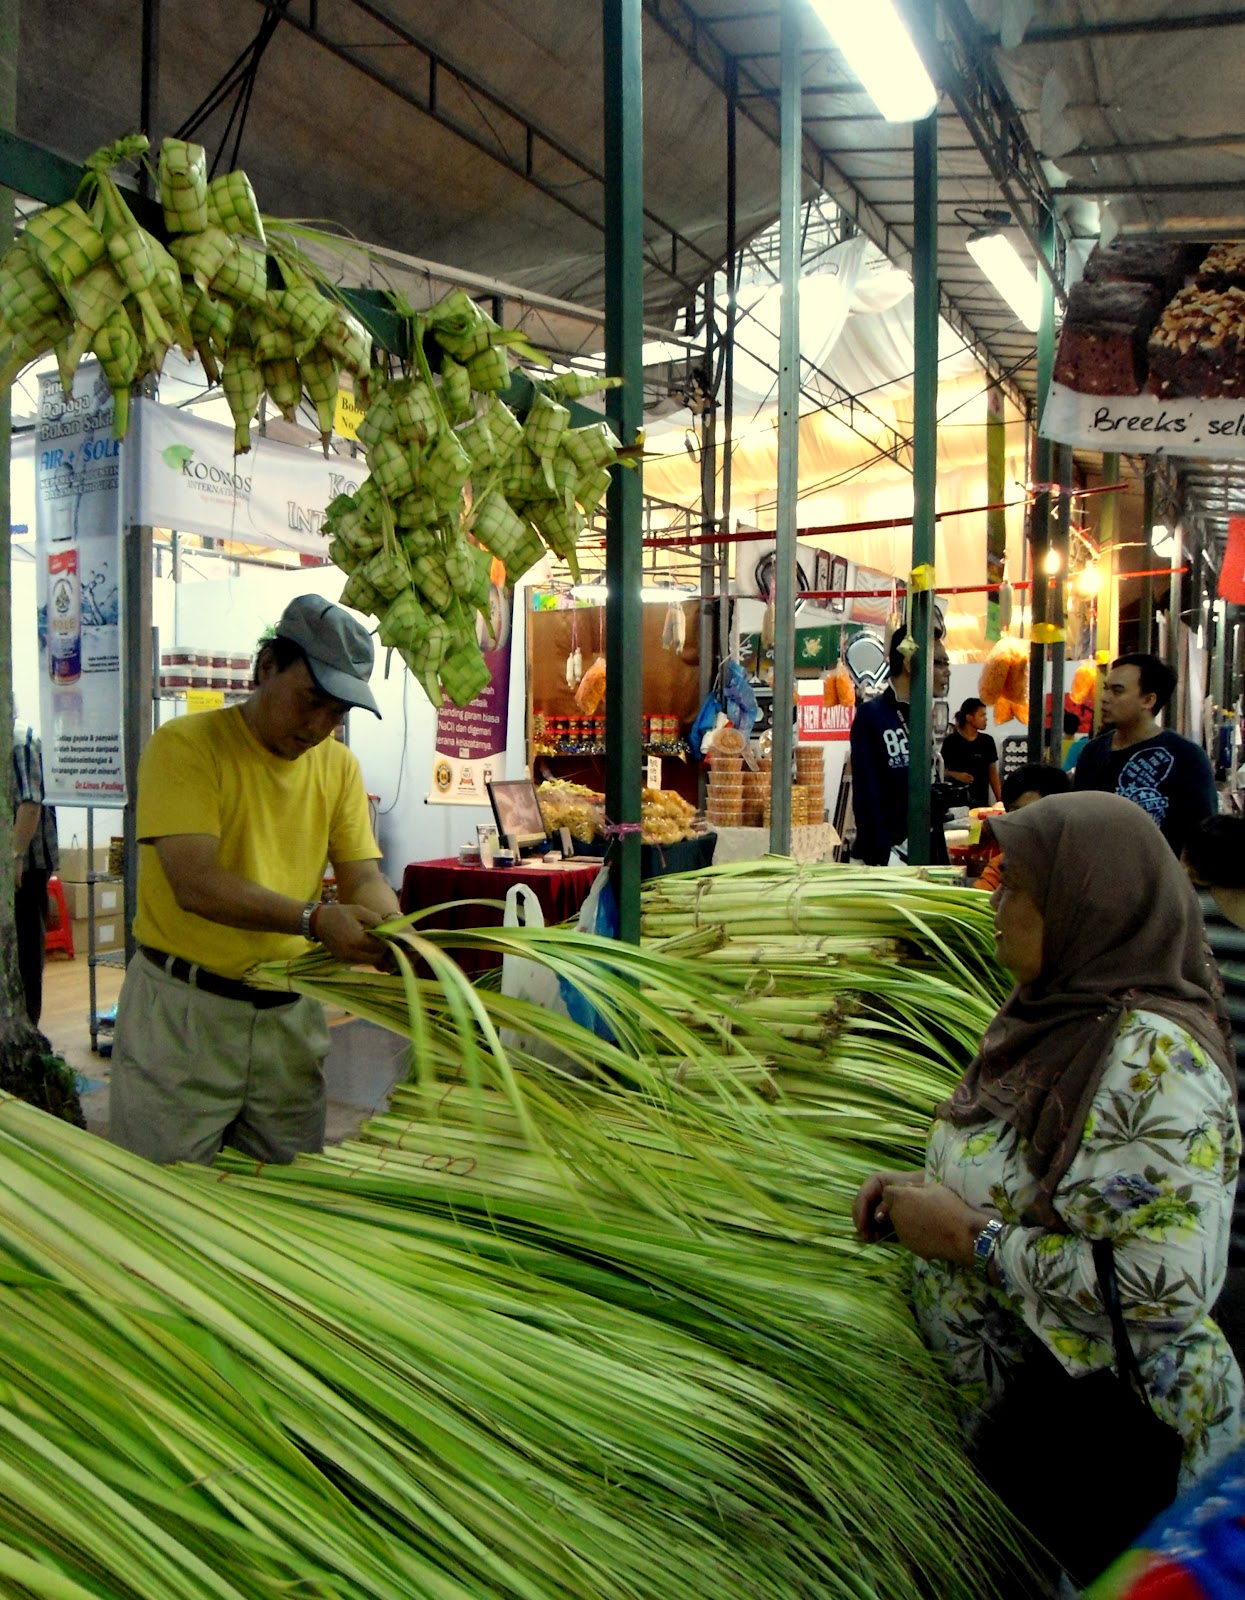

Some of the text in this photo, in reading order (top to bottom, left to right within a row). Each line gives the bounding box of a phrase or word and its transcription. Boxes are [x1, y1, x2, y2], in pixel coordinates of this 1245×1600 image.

[40, 419, 81, 441] Bukan
[40, 448, 64, 471] AIR
[182, 459, 252, 493] KOONOS
[456, 723, 467, 733] dan
[482, 712, 500, 724] biasa
[803, 705, 820, 729] NEW
[822, 704, 850, 729] CANVAS
[883, 728, 909, 757] 82
